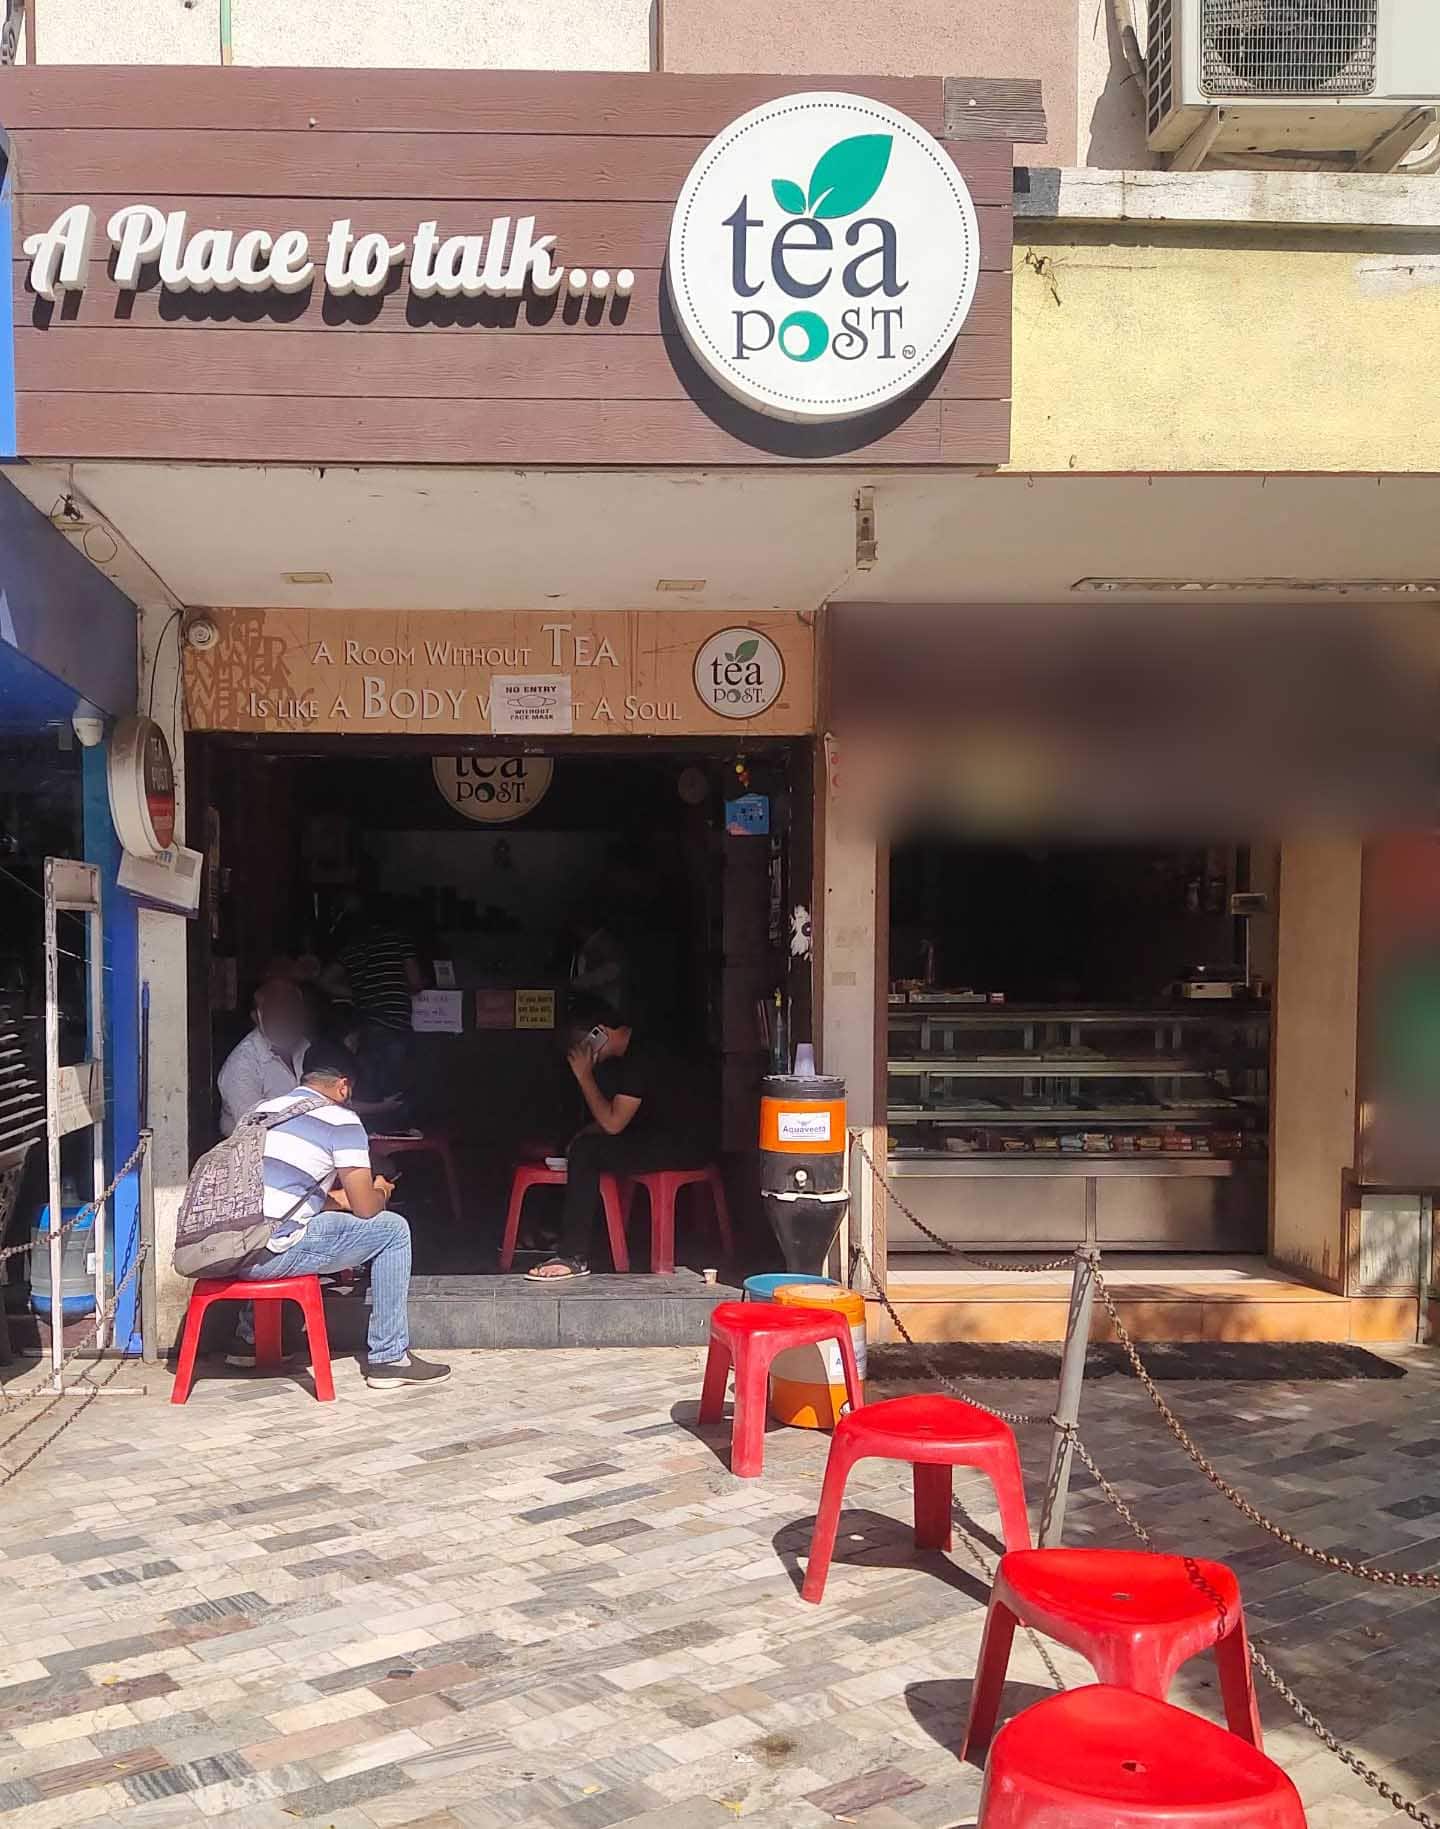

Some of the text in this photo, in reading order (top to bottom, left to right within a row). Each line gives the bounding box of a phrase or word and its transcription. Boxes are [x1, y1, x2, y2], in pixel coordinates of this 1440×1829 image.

[23, 203, 97, 301] A
[107, 203, 313, 293] Place
[323, 218, 406, 297] to
[721, 193, 910, 299] tea
[311, 640, 334, 665] A
[540, 623, 620, 668] TEA
[505, 685, 557, 694] NO ENTRY
[709, 655, 764, 686] tea
[328, 695, 351, 720] A
[362, 675, 467, 721] BODY
[592, 699, 616, 722] A
